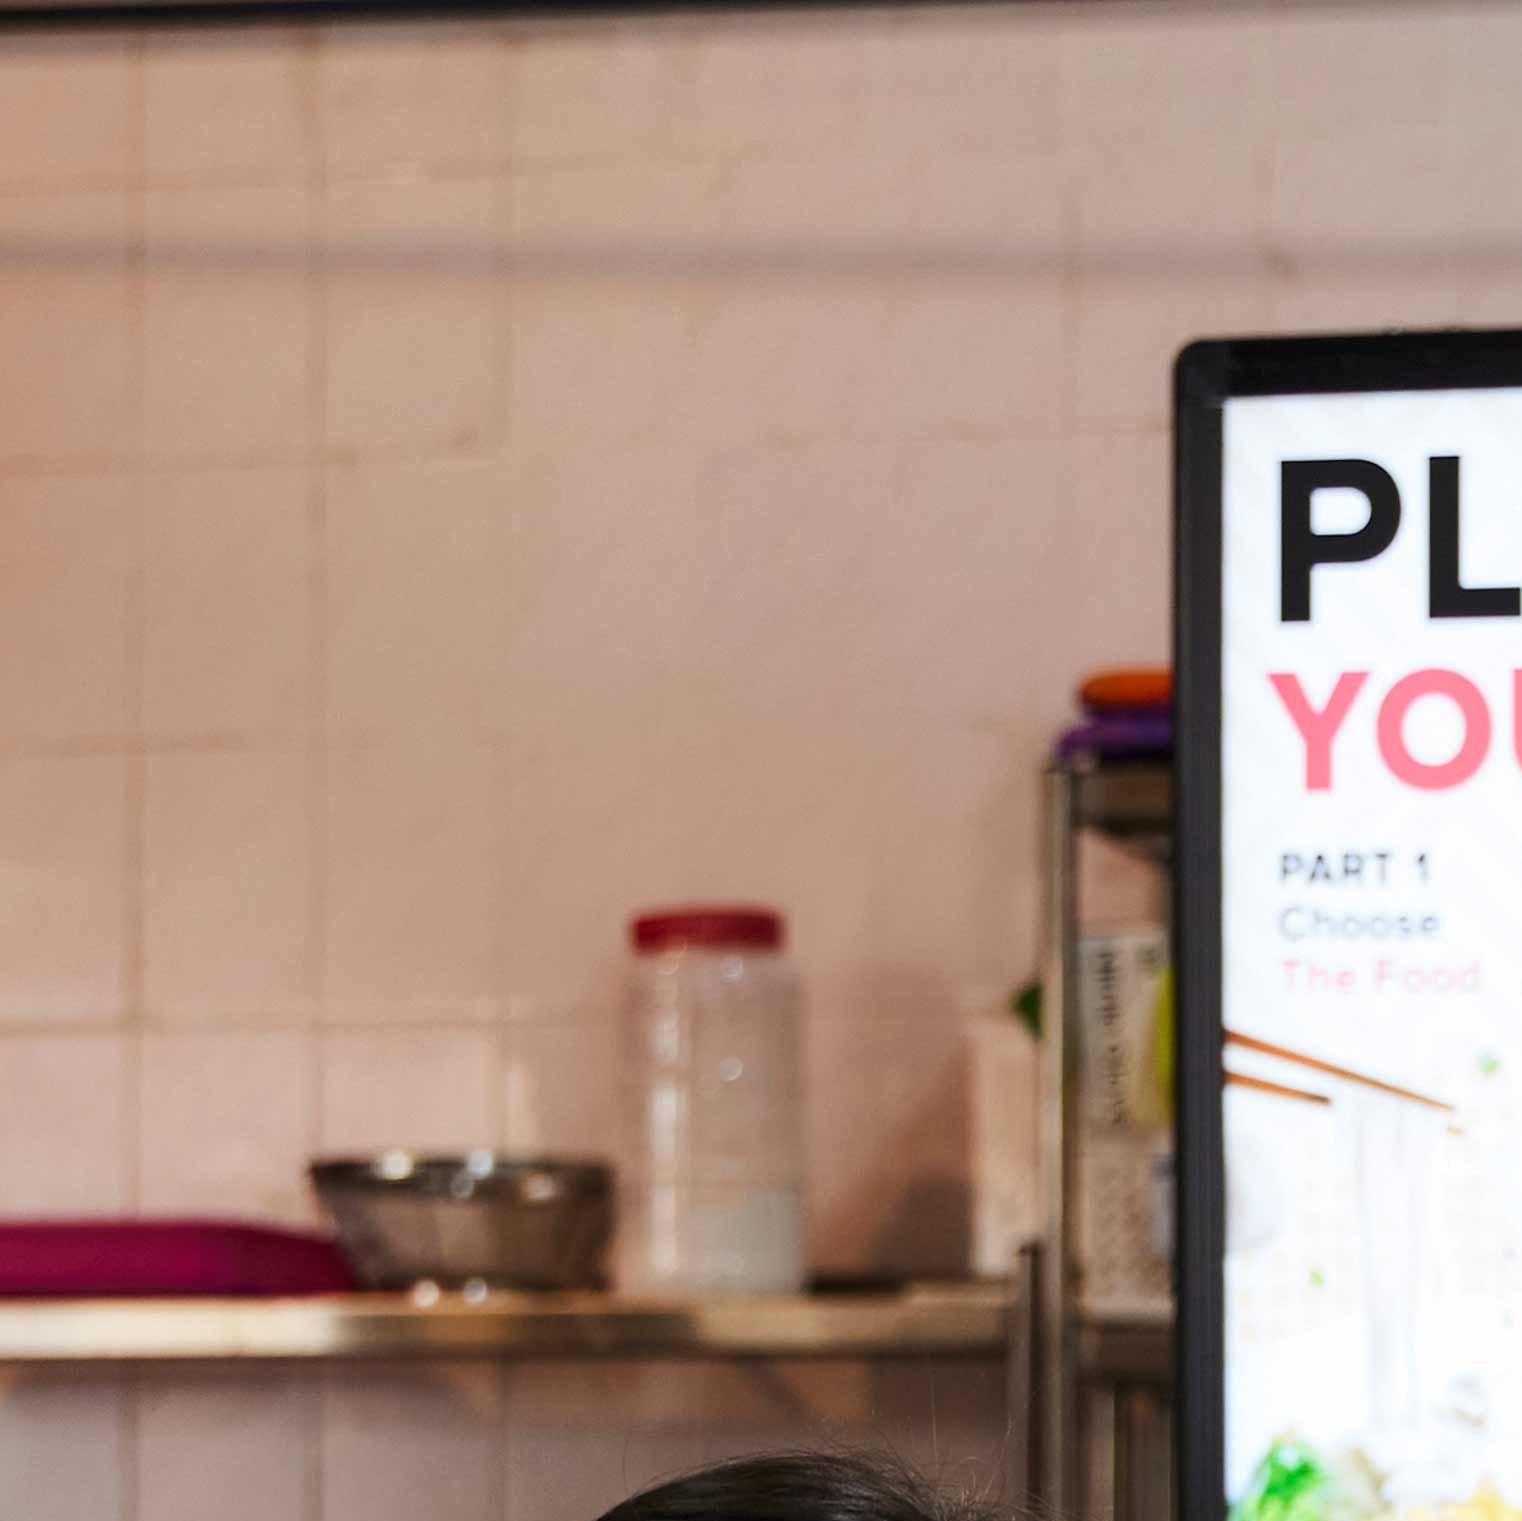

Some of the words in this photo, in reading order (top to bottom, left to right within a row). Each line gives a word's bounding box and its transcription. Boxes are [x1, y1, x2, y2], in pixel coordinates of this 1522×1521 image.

[1280, 851, 1391, 884] PART
[1415, 851, 1431, 882] 1
[1277, 906, 1441, 941] Choose
[1281, 959, 1353, 994] The
[1373, 957, 1483, 994] Food
